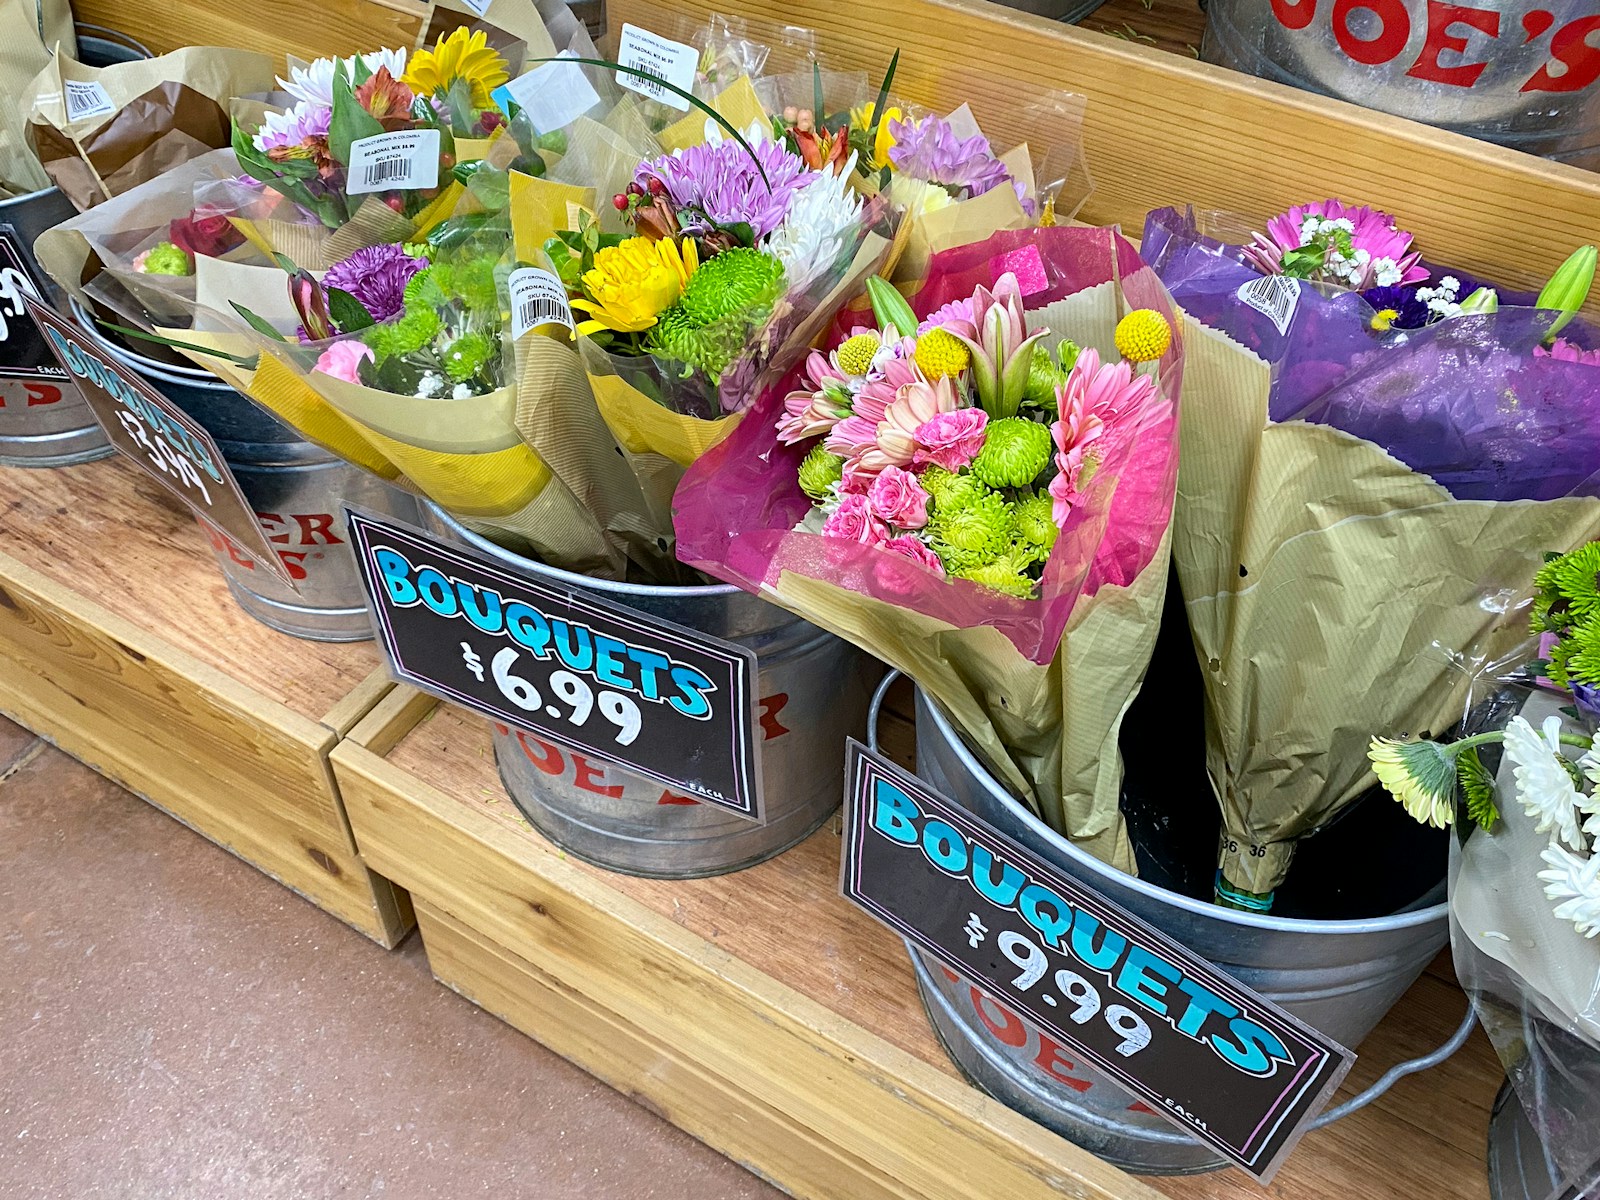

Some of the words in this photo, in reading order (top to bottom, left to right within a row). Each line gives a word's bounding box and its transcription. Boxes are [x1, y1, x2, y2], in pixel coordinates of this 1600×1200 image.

[629, 43, 652, 56] SEASONAL
[364, 147, 390, 157] SEASONAL
[1246, 297, 1263, 312] Product
[1250, 292, 1267, 304] 0058
[371, 545, 718, 720] BOUQUETS
[461, 642, 642, 746] $6.99
[689, 783, 724, 799] EACH
[1249, 844, 1267, 858] 36
[869, 774, 1296, 1078] BOUQUETS
[963, 912, 1152, 1058] $9.99
[1164, 1097, 1208, 1132] EACH
